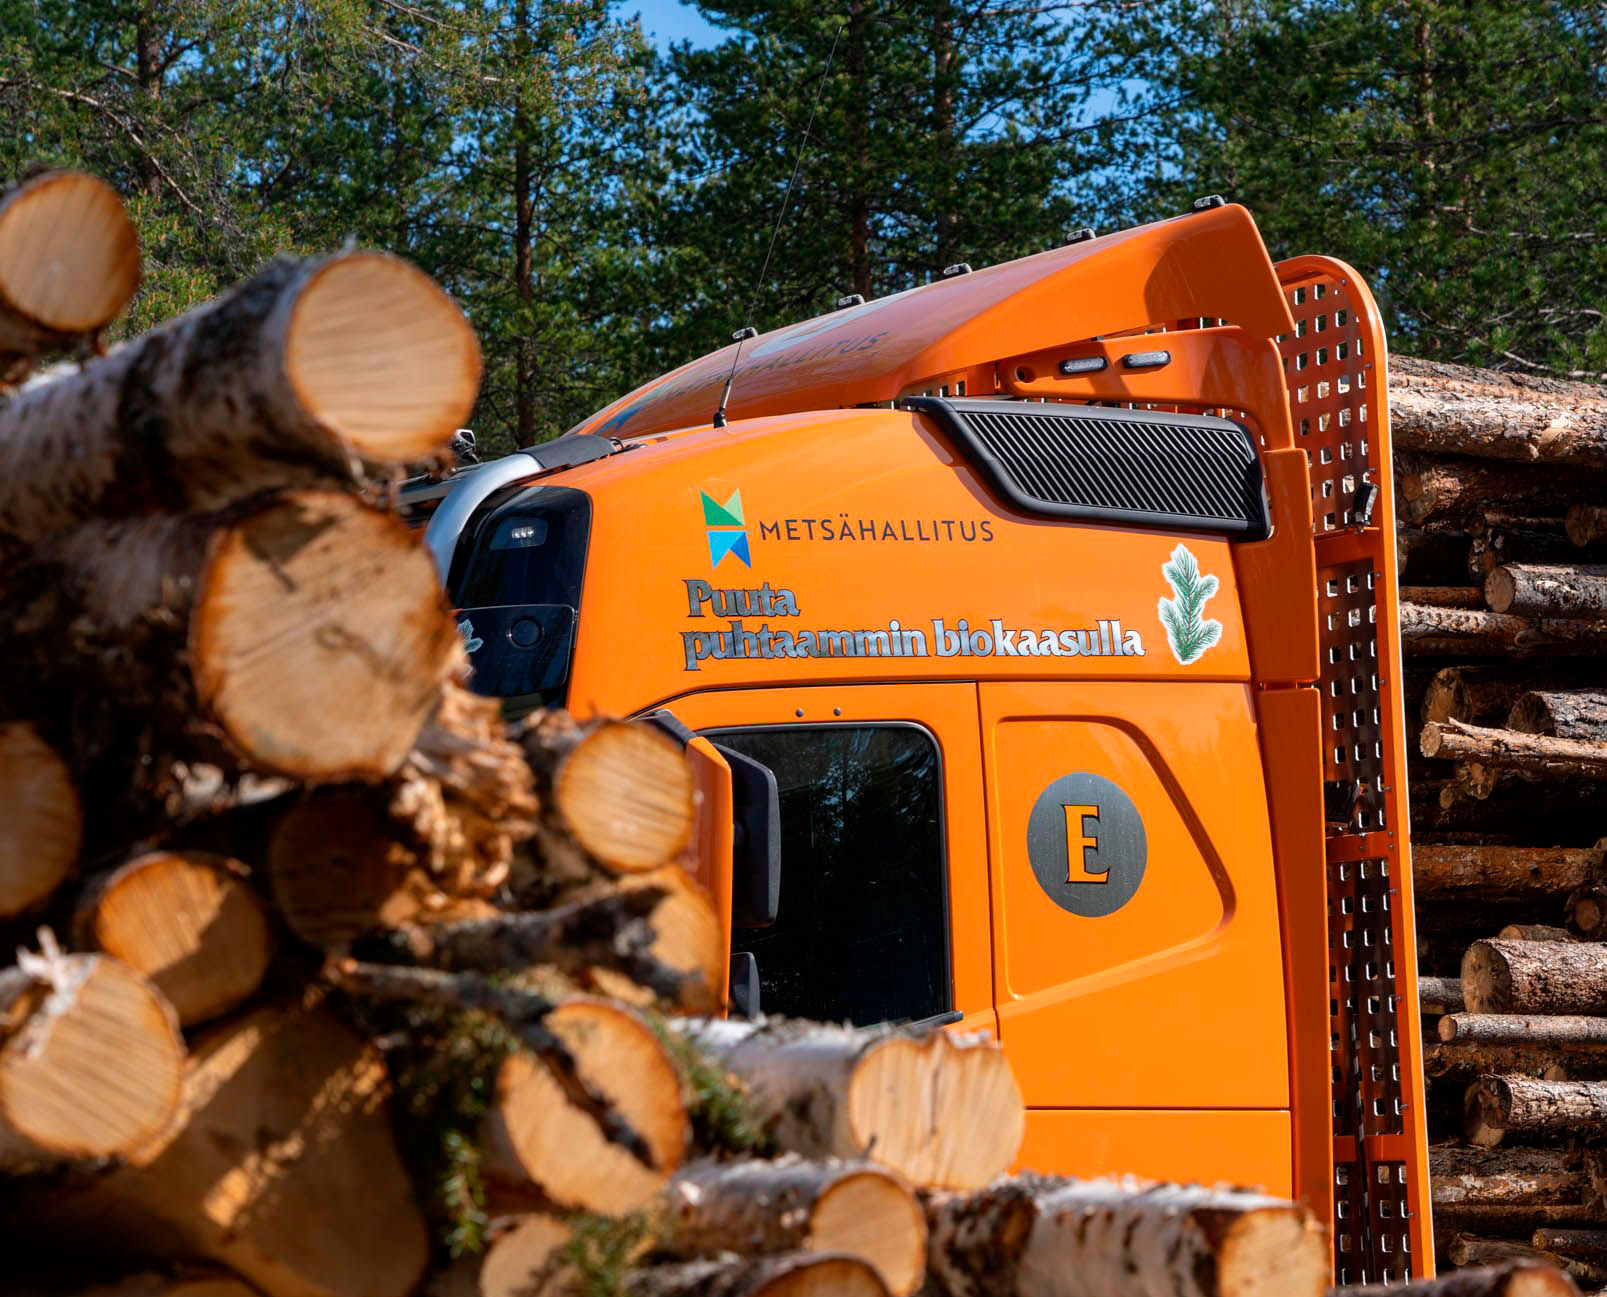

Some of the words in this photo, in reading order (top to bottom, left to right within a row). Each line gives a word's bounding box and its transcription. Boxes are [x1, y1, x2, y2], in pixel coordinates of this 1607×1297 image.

[759, 513, 994, 542] METSÄHALLITUS
[682, 579, 801, 617] Puuta
[679, 619, 931, 671] puhtaammin
[931, 618, 1146, 657] biokaasulla
[1061, 804, 1112, 884] E
